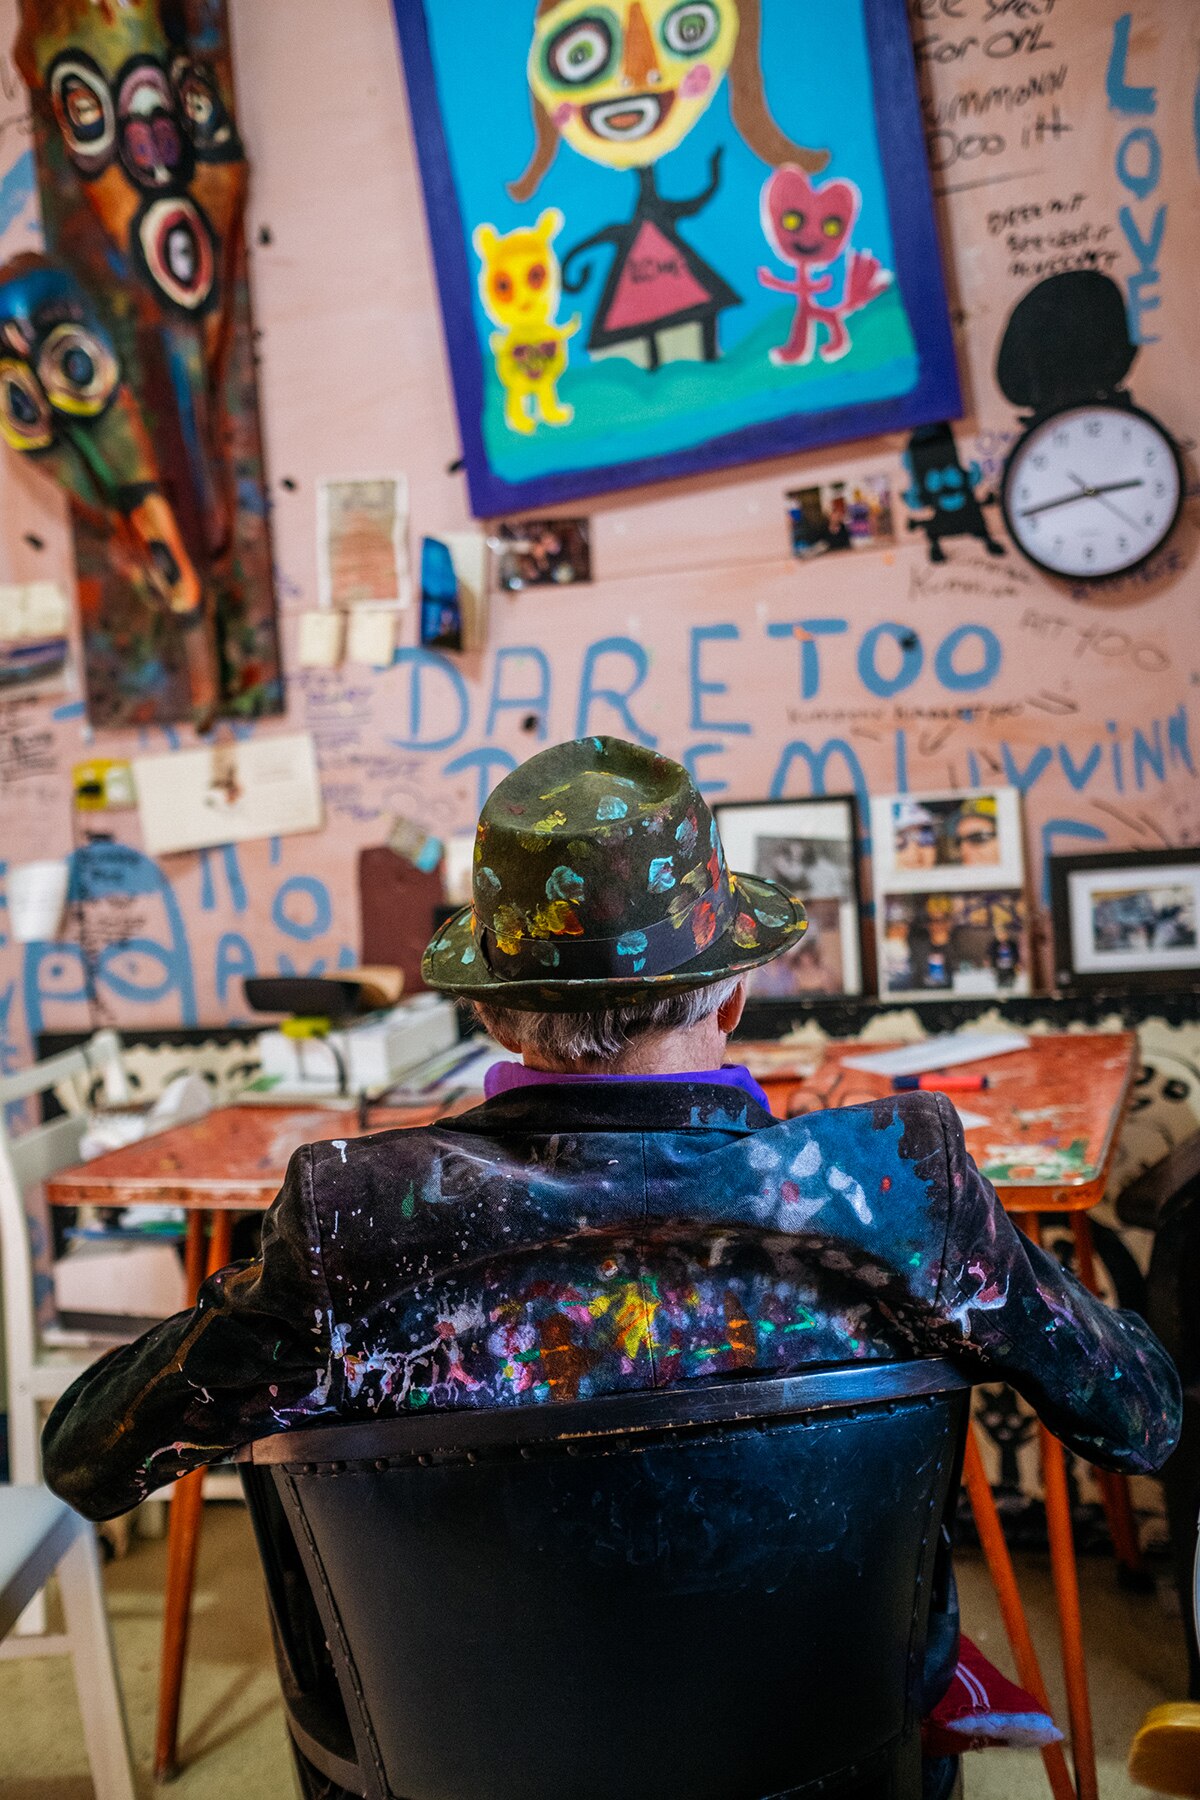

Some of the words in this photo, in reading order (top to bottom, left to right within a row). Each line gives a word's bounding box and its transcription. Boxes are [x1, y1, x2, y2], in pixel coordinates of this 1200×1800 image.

[1106, 12, 1168, 346] LOVE
[374, 623, 753, 751] DARE
[766, 617, 1003, 701] TOO
